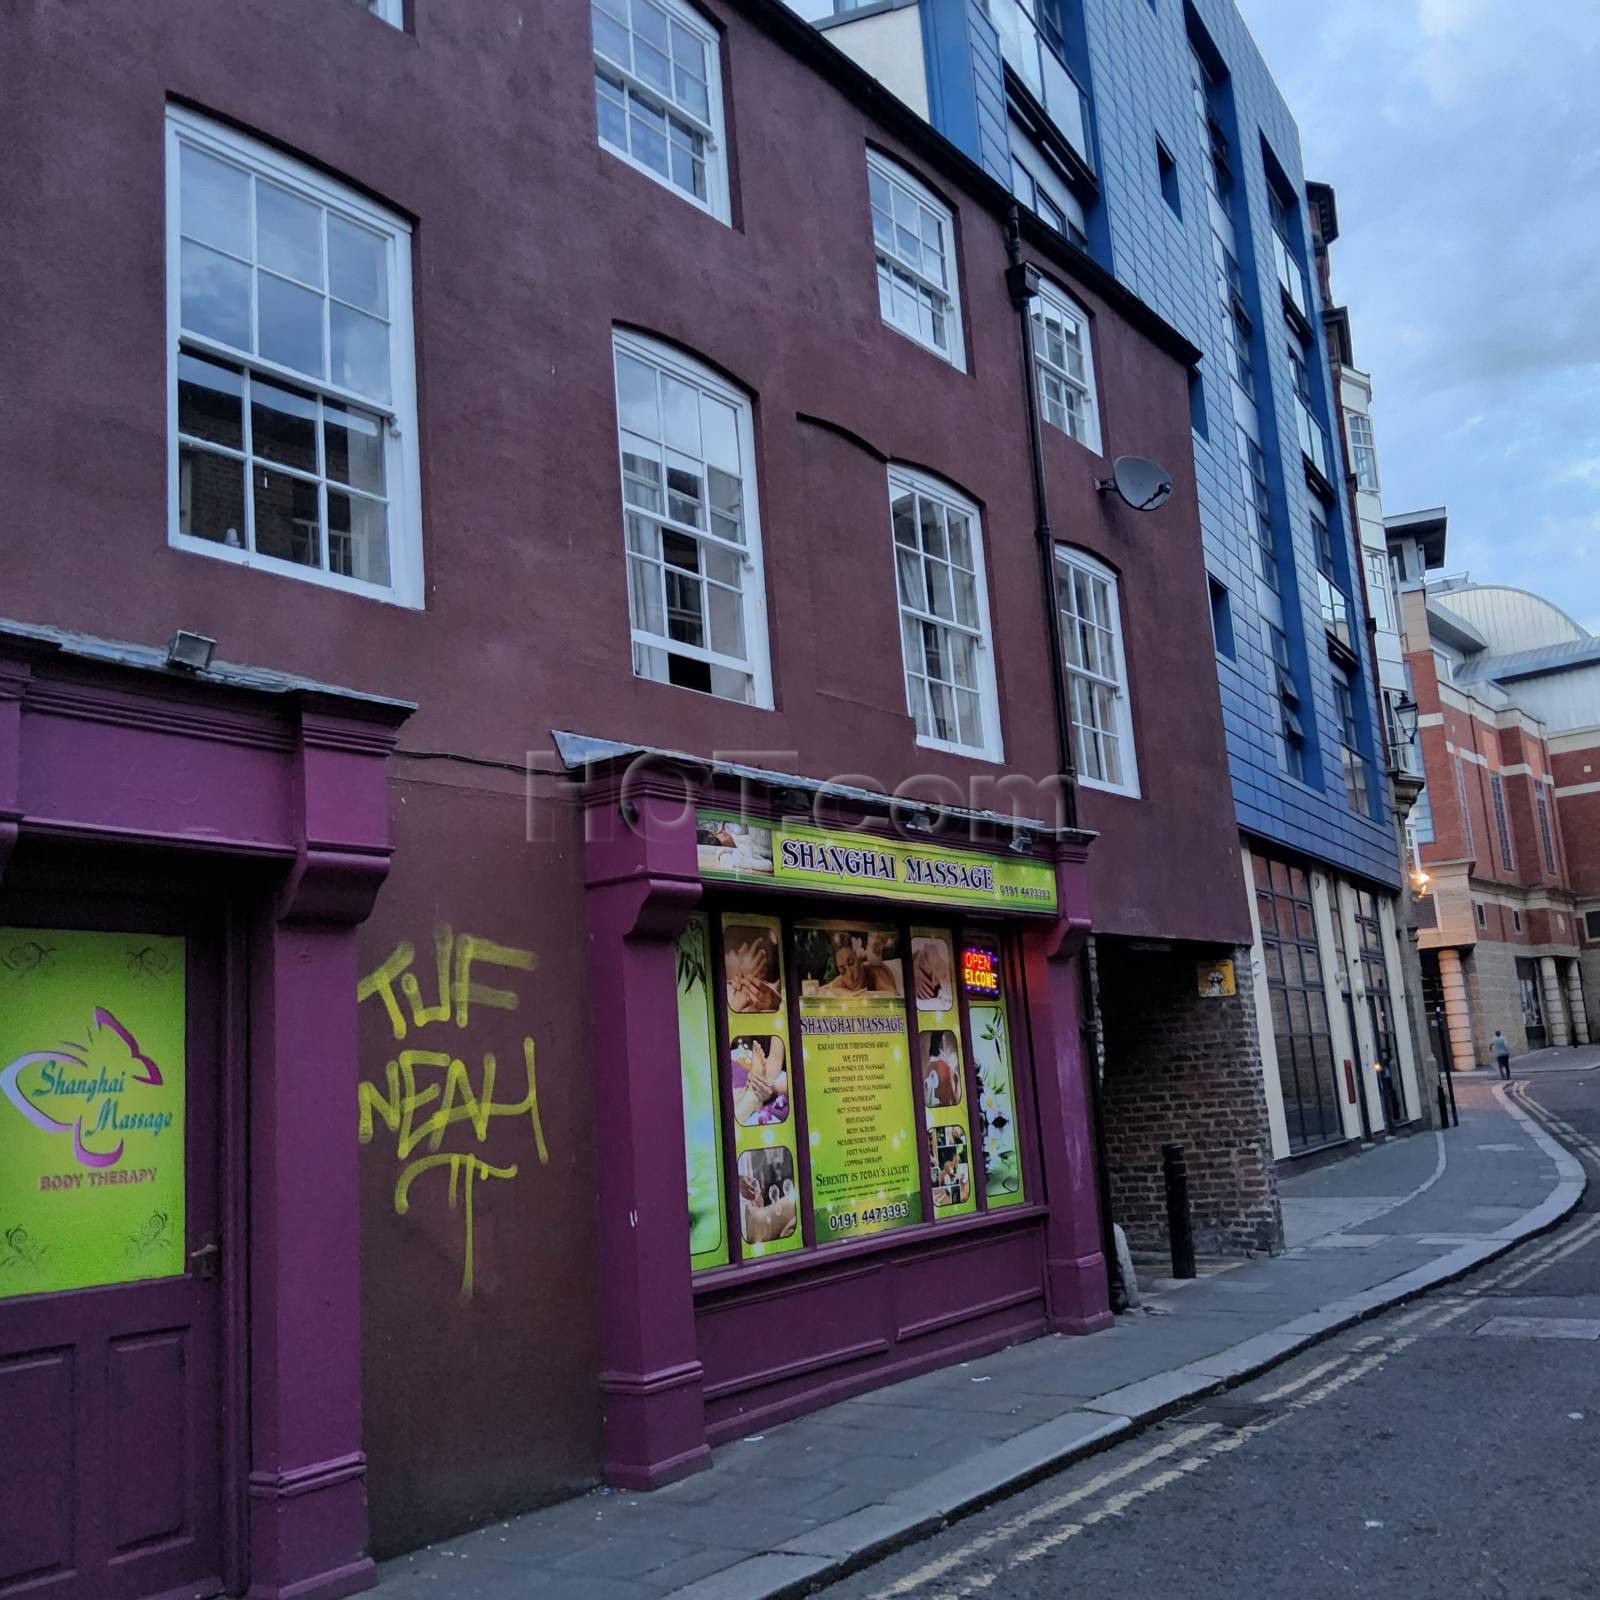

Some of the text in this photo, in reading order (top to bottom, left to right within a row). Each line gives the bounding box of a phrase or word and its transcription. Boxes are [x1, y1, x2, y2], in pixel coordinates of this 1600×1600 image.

[781, 839, 995, 892] SHANGHAI MASSAGE
[999, 884, 1051, 899] 0191 4473393
[964, 952, 991, 971] OPEN
[800, 1015, 904, 1034] SHANGHAI MASSAGE
[32, 1060, 126, 1102] Shanghai
[85, 1097, 173, 1137] Massage
[39, 1168, 158, 1192] BODY THERAPY
[829, 1201, 908, 1231] 0191 4473393
